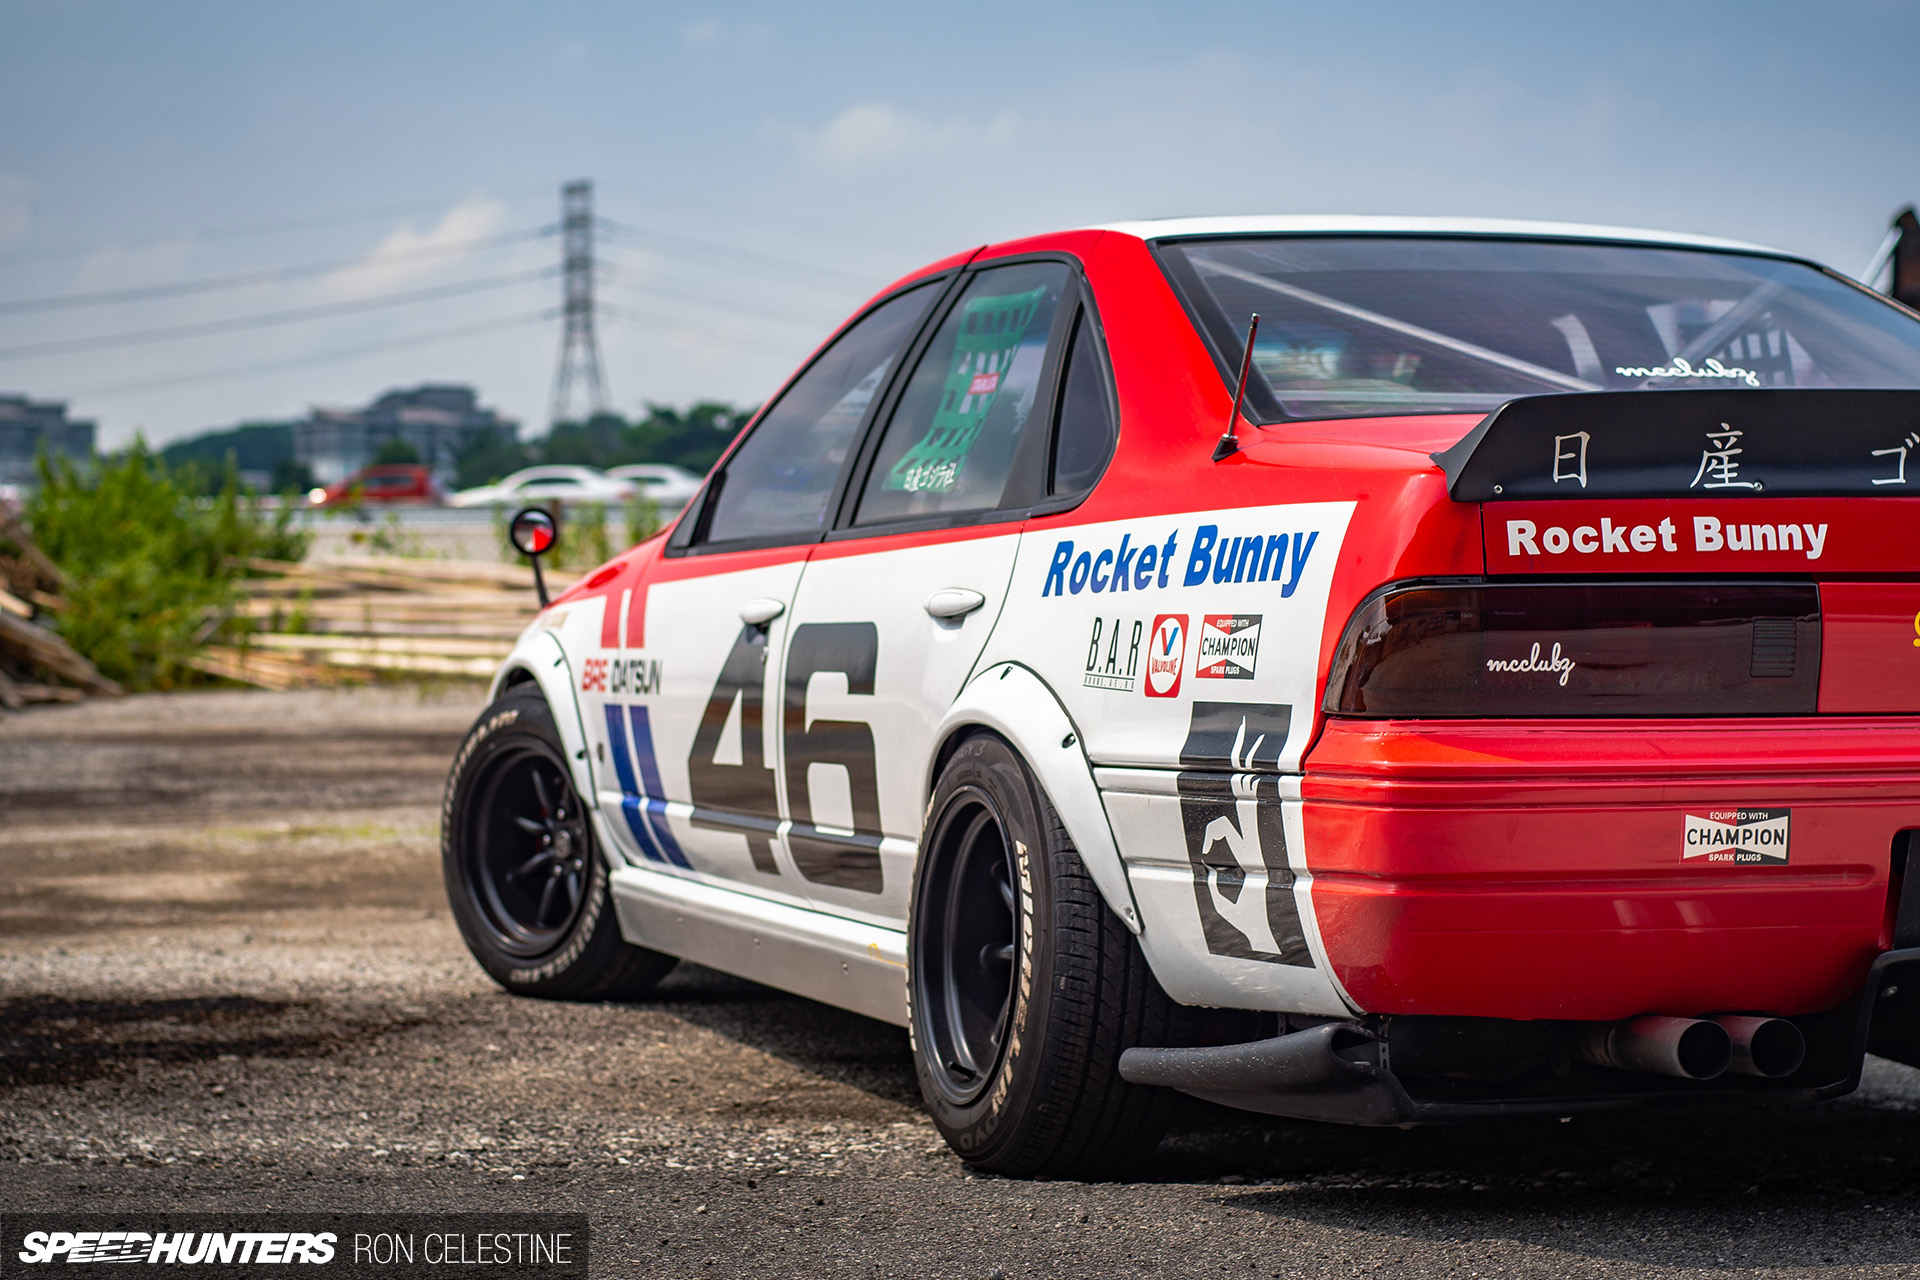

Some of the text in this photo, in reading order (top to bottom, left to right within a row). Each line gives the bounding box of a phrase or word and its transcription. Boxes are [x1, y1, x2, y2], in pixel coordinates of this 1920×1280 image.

[1506, 516, 1828, 560] Rocket Bunny
[1042, 524, 1320, 599] Rocket Bunny
[1216, 619, 1250, 628] EQUIPPED WITH
[1085, 617, 1142, 676] B.A.R
[1202, 637, 1256, 656] CHAMPION
[582, 658, 663, 695] BRE DATSUN
[1152, 657, 1178, 676] VALVOLINE
[1210, 666, 1240, 675] SPARK PLUGS
[1486, 642, 1576, 687] mcclubz
[688, 618, 884, 895] 46
[1709, 811, 1768, 820] EQUIPPED WITH
[1687, 828, 1785, 846] CHAMPION
[1708, 853, 1761, 862] SPARK PLUGS
[992, 839, 1034, 1117] MICHELIN
